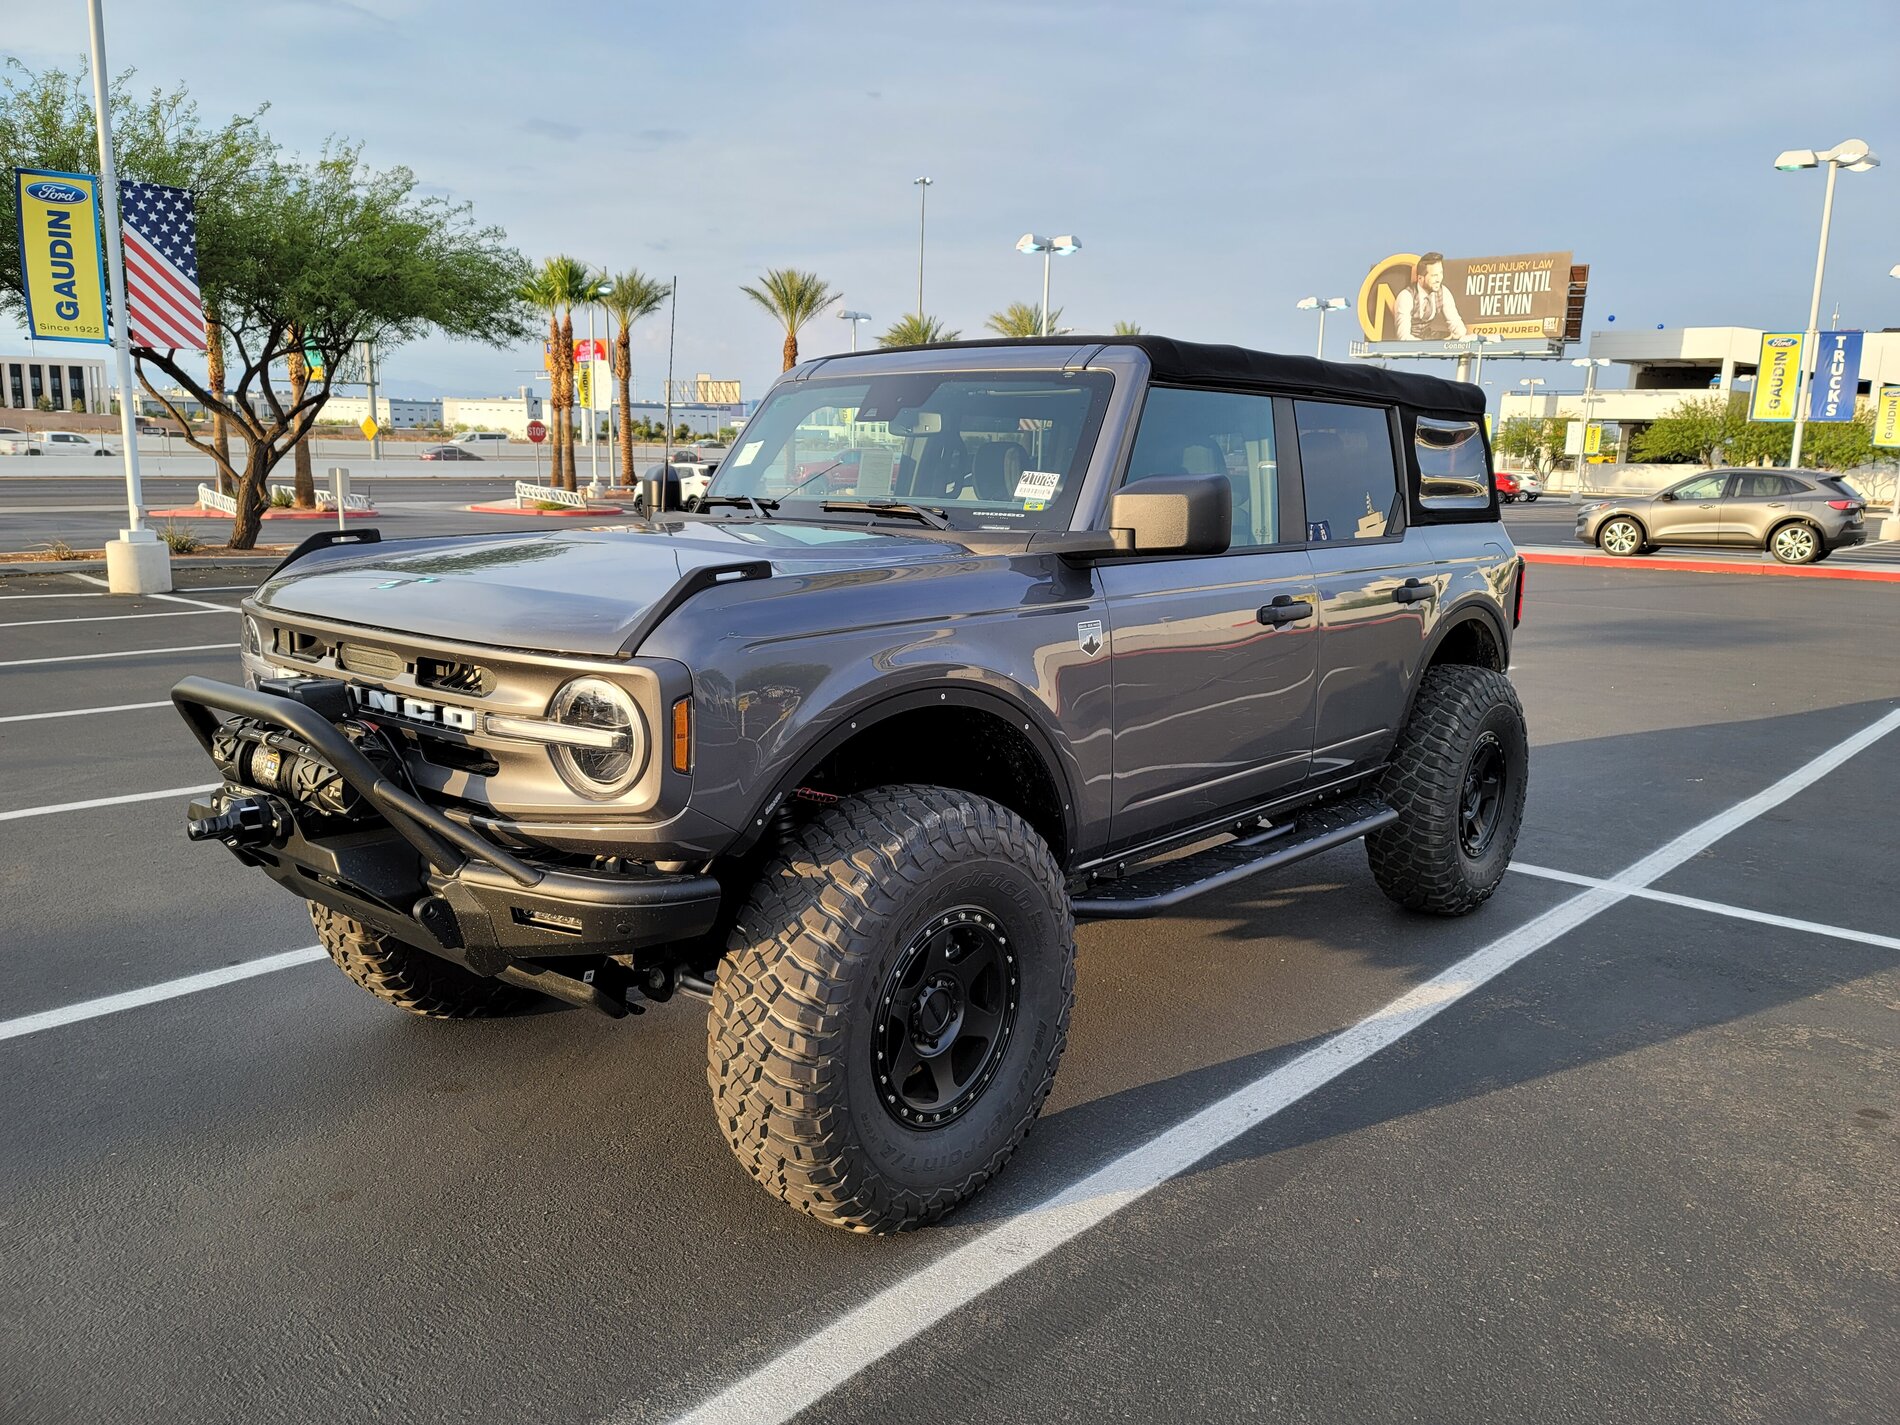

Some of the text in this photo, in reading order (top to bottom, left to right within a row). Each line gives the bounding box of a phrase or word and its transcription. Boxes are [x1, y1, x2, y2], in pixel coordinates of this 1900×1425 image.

[38, 183, 76, 202] Ford
[47, 210, 80, 321] GAUDIN
[1468, 259, 1554, 274] NAQVI INJURY LAW
[1465, 270, 1552, 296] NO FEE UNTIL
[1480, 293, 1533, 316] WE WIN
[39, 322, 101, 334] Since 1922
[1472, 326, 1498, 335] (702)
[1499, 325, 1541, 334] INJURED
[1768, 351, 1788, 409] GAUDIN
[1825, 335, 1847, 417] TRUCKS
[1884, 399, 1898, 439] GAUDIN
[528, 427, 546, 436] STOP
